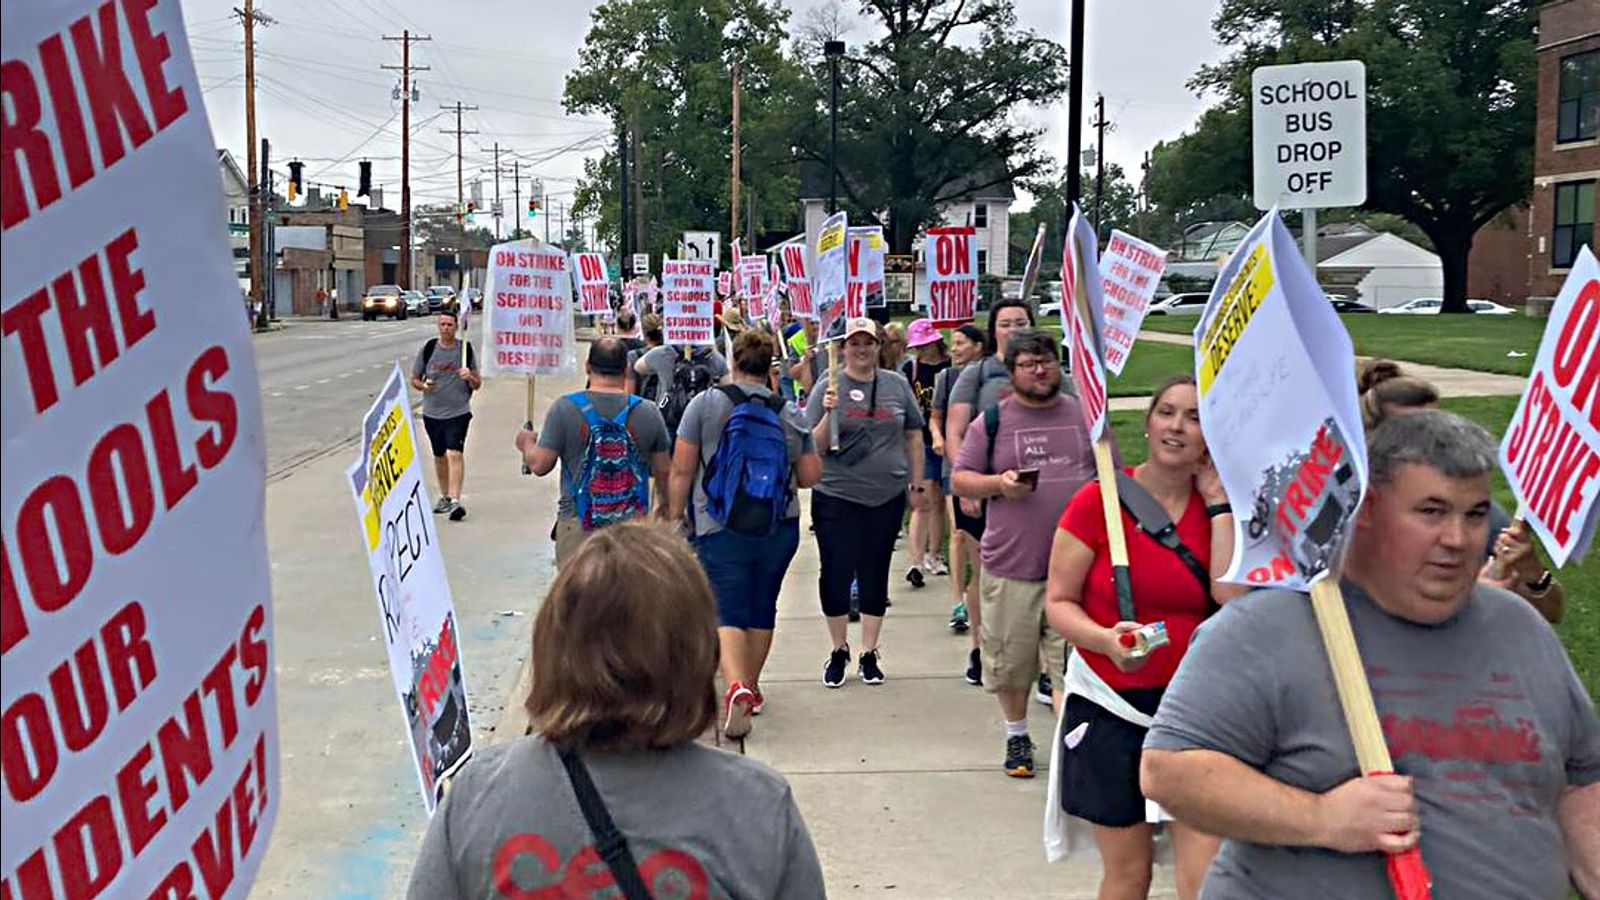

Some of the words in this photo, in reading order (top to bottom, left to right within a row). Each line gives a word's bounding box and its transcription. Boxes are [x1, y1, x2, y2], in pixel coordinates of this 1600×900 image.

[1260, 80, 1357, 105] SCHOOL
[1286, 111, 1333, 133] BUS
[1277, 141, 1342, 163] DROP
[1288, 171, 1333, 193] OFF
[496, 251, 515, 267] ON
[519, 253, 565, 271] STRIKE
[784, 245, 805, 278] ON
[936, 235, 969, 276] ON
[580, 254, 603, 281] ON
[666, 263, 678, 274] ON
[680, 263, 711, 275] STRIKE
[509, 274, 531, 288] FOR
[533, 275, 553, 289] THE
[496, 292, 564, 311] SCHOOLS
[582, 284, 608, 311] STRIKE
[666, 291, 711, 302] SCHOOLS
[931, 279, 975, 320] STRIKE
[1104, 278, 1147, 312] CHOOLS
[519, 313, 543, 327] OUR
[682, 304, 697, 314] OUR
[3, 227, 156, 415] THE
[665, 316, 712, 327] STUDENTS
[496, 331, 563, 348] STUDENTS
[497, 351, 560, 367] DESERVE!
[1025, 445, 1047, 455] ALL
[1507, 370, 1600, 549] STRIKE
[378, 479, 430, 644] RPECT
[1246, 549, 1295, 582] ON
[0, 601, 157, 802] OUR
[0, 604, 268, 900] DENTS
